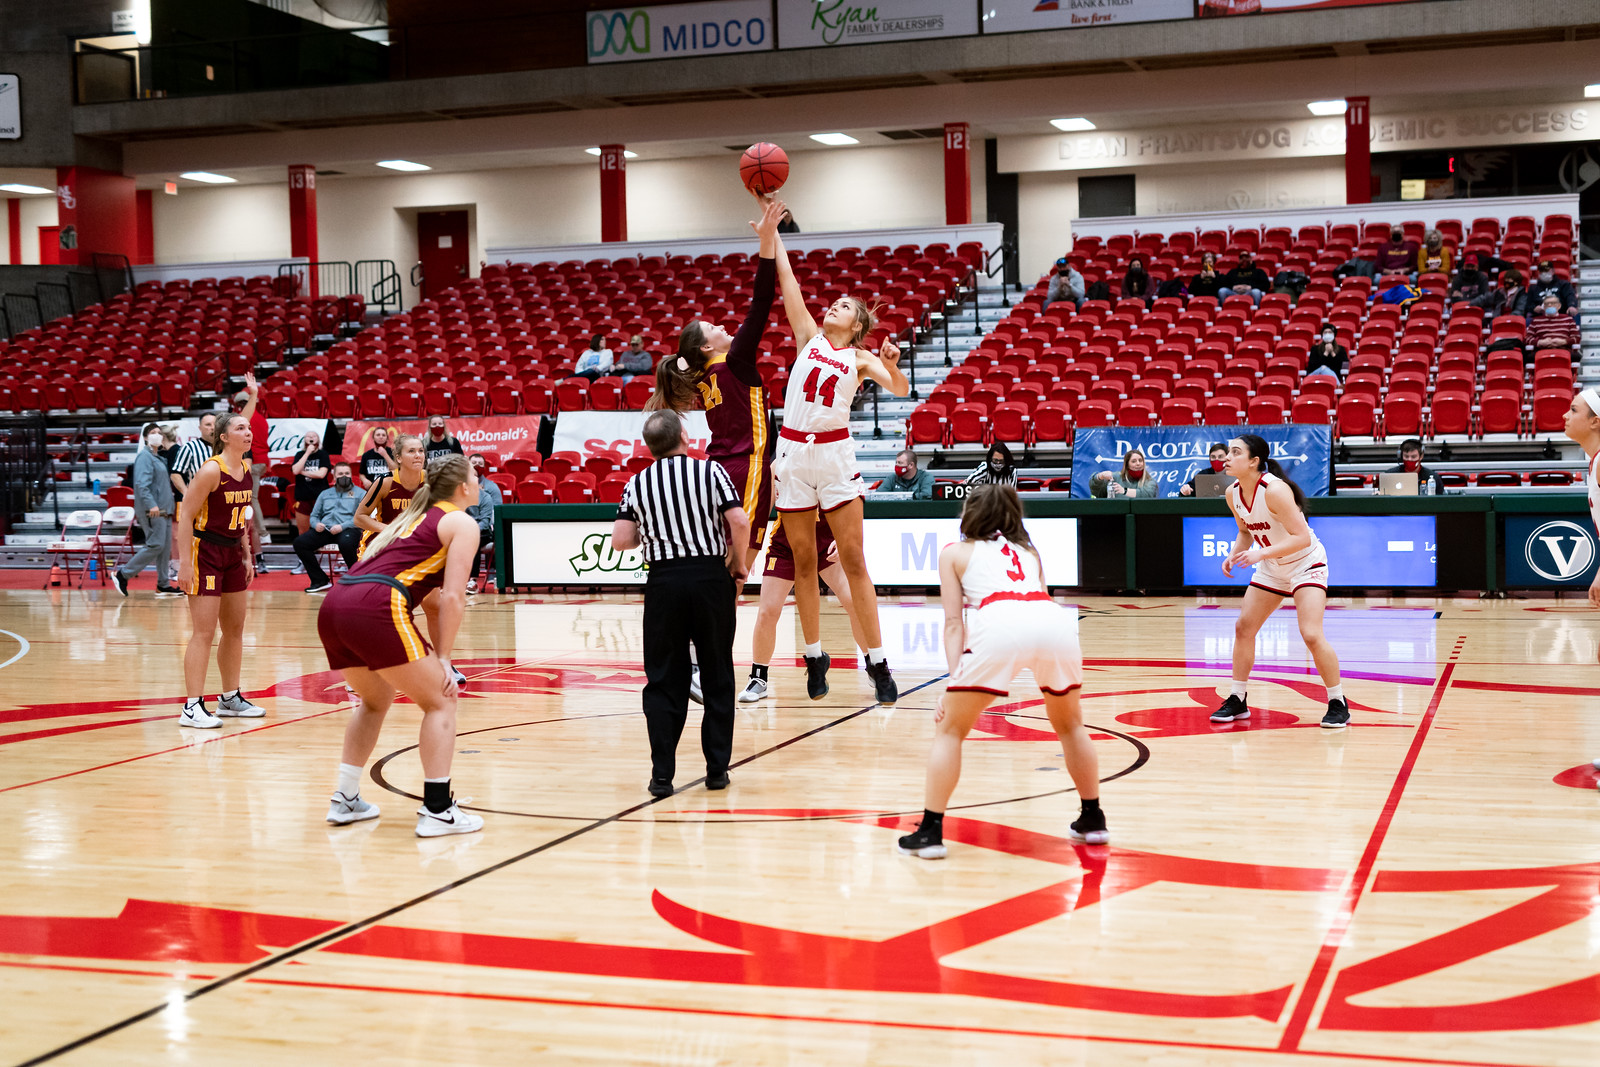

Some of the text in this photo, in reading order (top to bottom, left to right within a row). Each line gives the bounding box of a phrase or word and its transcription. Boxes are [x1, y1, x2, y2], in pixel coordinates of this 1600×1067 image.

[811, 0, 880, 44] Ryan
[846, 17, 945, 35] FAMILY DEALERSHIPS
[1071, 12, 1113, 25] live first
[662, 17, 766, 52] MIDCO
[946, 132, 964, 150] 12
[1058, 136, 1128, 160] DEAN
[1137, 127, 1292, 156] FRANTSVOG
[1456, 108, 1589, 137] SUCCESS
[601, 154, 617, 170] 12
[290, 174, 304, 189] 13
[808, 348, 850, 375] Beavers
[803, 366, 840, 408] 44
[456, 427, 529, 442] McDonald's
[469, 444, 498, 453] Supports
[1001, 543, 1026, 582] 3
[206, 575, 215, 590] N
